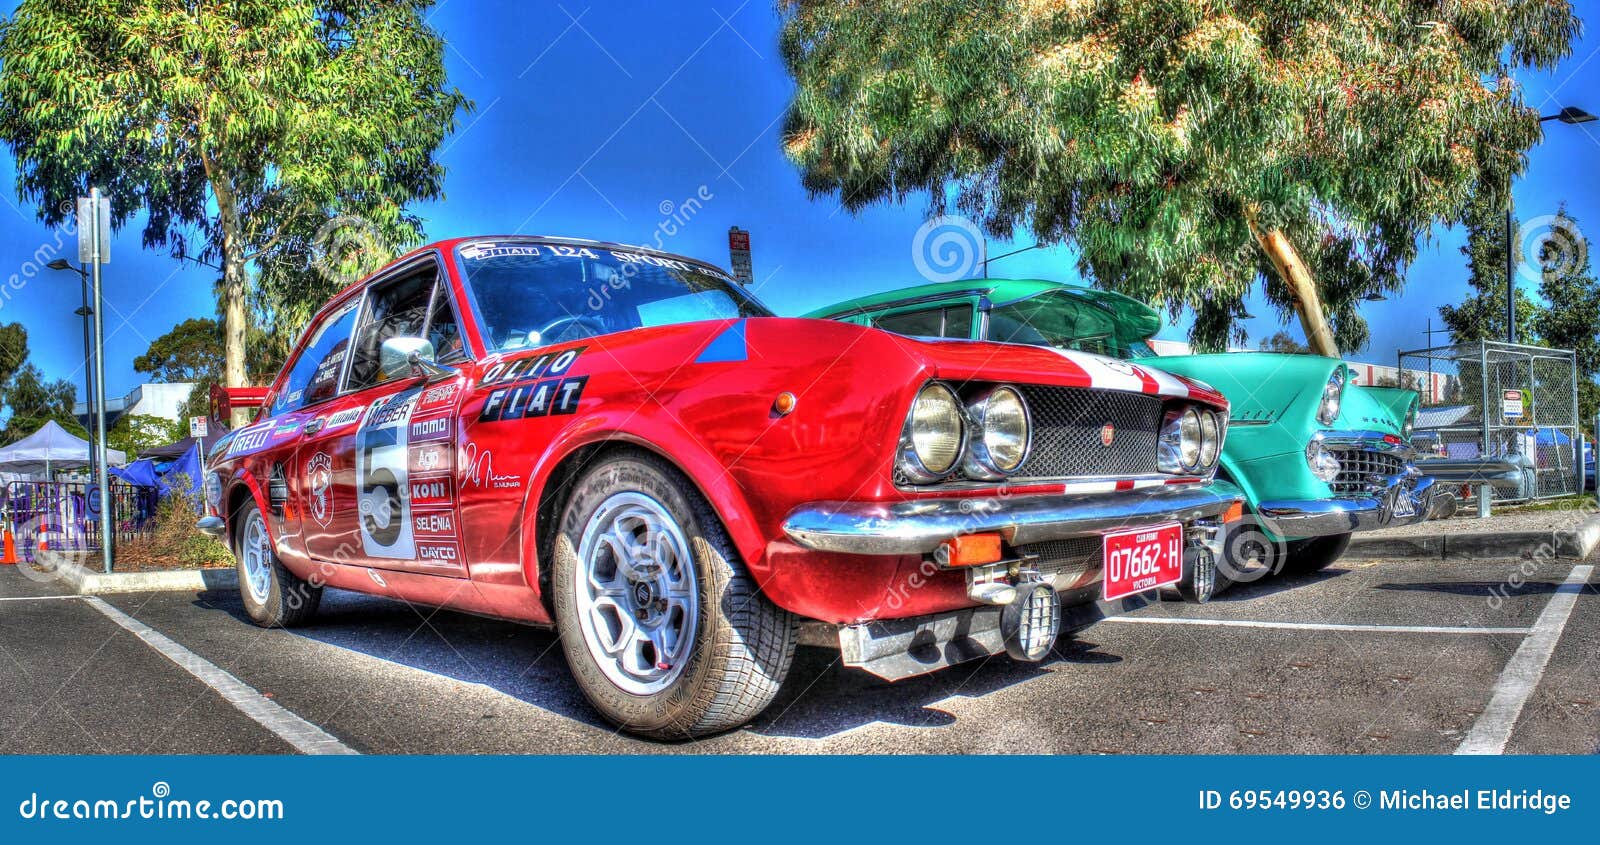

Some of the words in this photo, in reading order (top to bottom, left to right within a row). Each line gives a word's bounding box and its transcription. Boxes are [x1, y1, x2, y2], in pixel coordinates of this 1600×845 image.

[479, 247, 539, 259] FIAT
[544, 245, 600, 259] 124
[611, 251, 693, 272] SPORT
[483, 350, 577, 383] OLIO
[484, 382, 580, 416] FIAT
[366, 403, 410, 427] WEBER
[229, 420, 277, 455] PIRELLI
[364, 427, 402, 548] 5
[412, 482, 445, 498] KONI
[416, 514, 451, 532] SELENIA
[420, 546, 456, 560] DAYCO
[1133, 576, 1157, 590] VICTORIA
